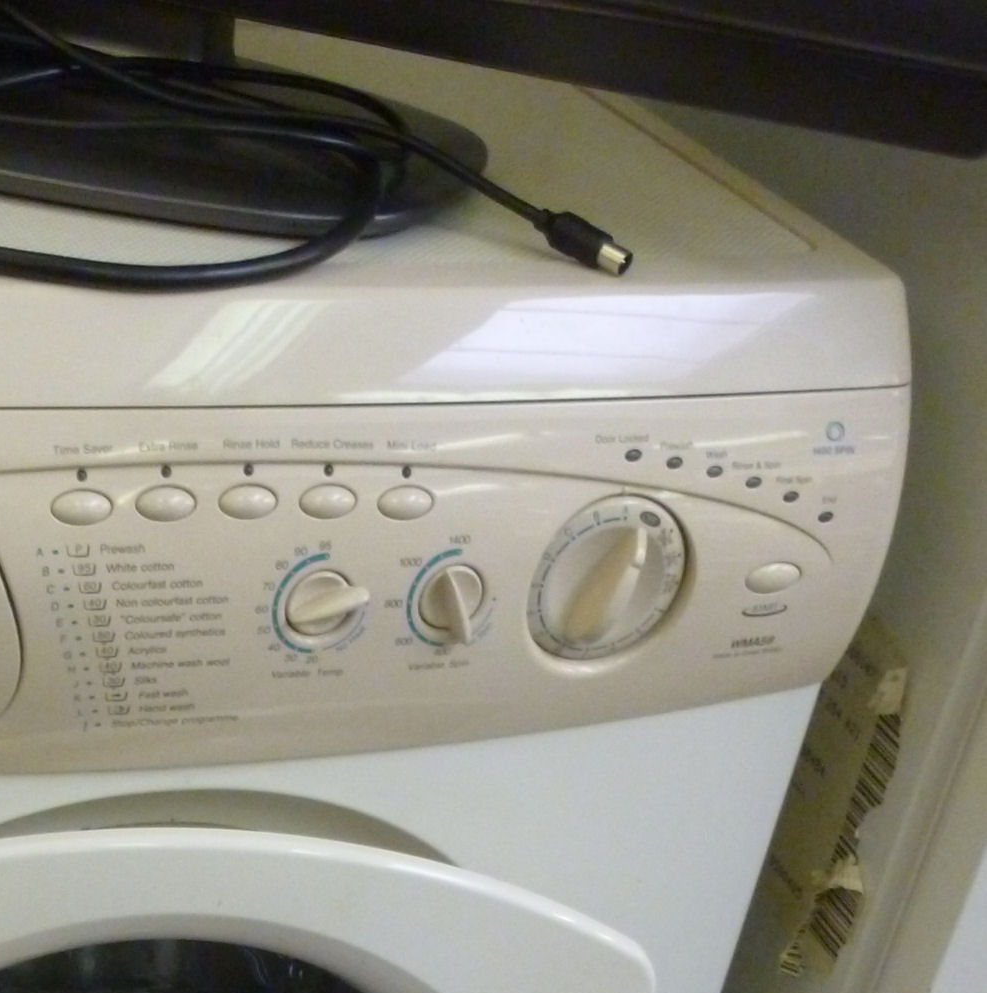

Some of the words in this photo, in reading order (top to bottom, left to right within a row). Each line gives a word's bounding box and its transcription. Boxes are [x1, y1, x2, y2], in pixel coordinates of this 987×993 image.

[168, 440, 199, 451] Rinse
[222, 439, 253, 450] Rinse
[255, 439, 280, 450] Hold
[291, 439, 330, 450] Reduce
[333, 439, 374, 450] Creases
[387, 440, 410, 450] Mini
[53, 445, 80, 456] Time
[35, 547, 44, 557] A
[100, 543, 146, 554] Prewash
[106, 563, 138, 574] White
[140, 562, 175, 573] cotton
[111, 579, 167, 591] Colourfast
[169, 578, 204, 589] cotton
[115, 598, 138, 608] Non
[196, 595, 230, 606] cotton
[189, 611, 223, 622] cotton
[124, 630, 173, 641] Coloured
[130, 660, 175, 670] Machine
